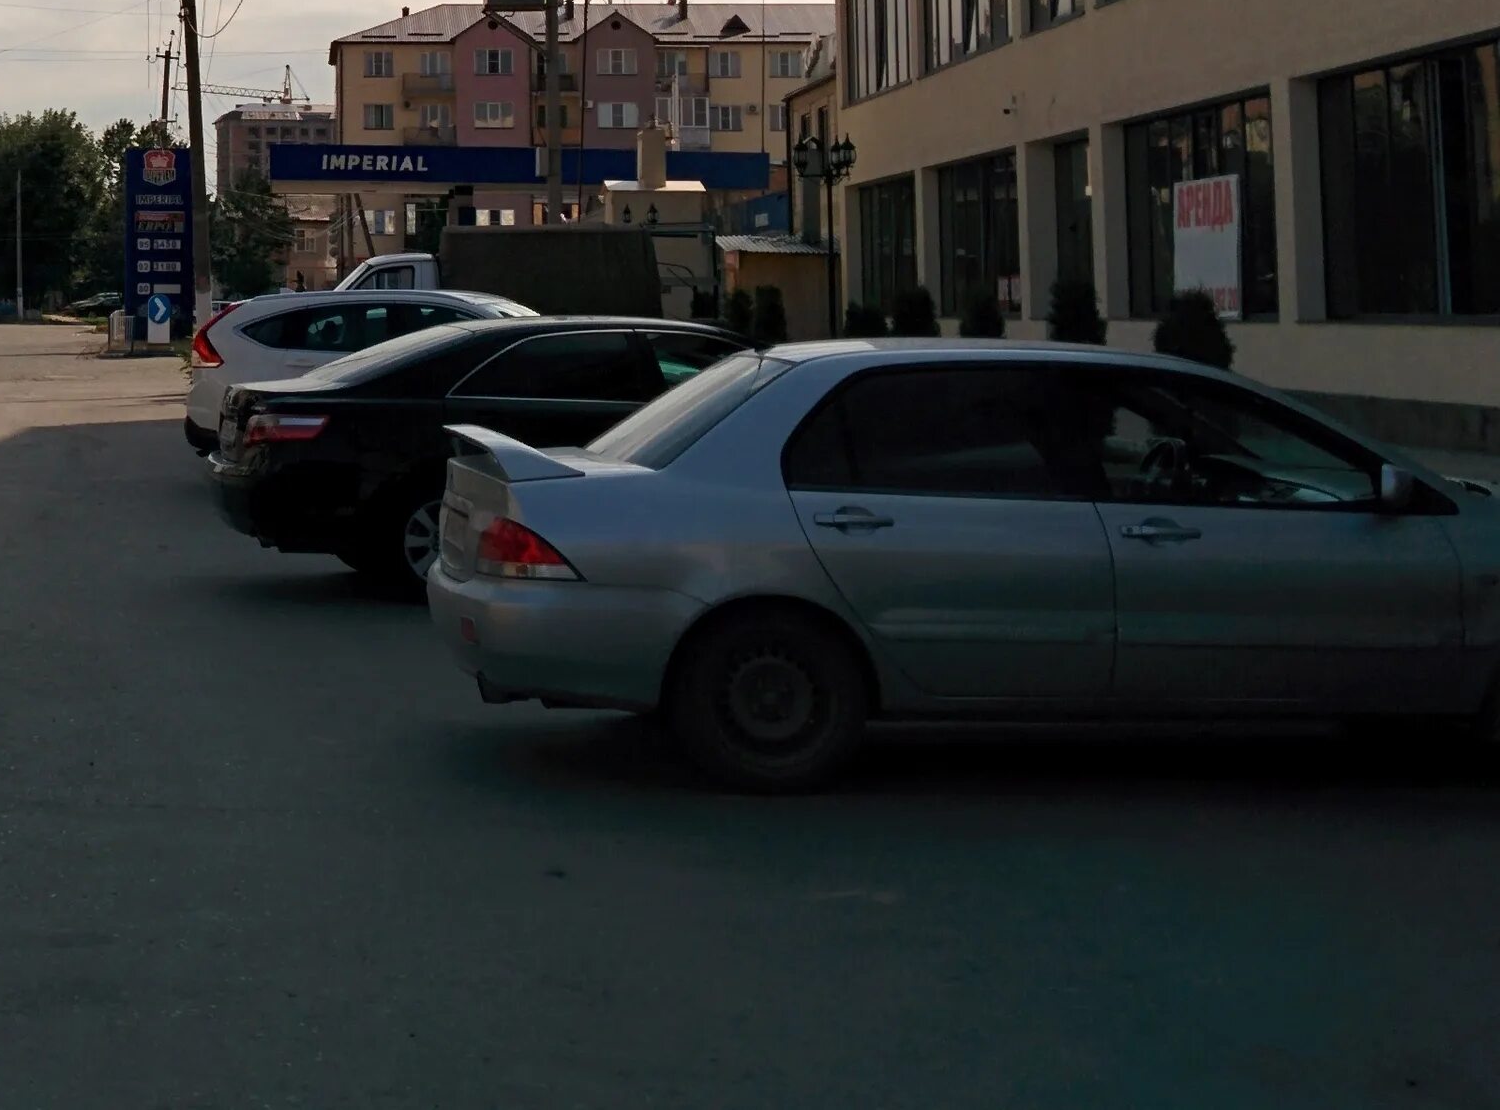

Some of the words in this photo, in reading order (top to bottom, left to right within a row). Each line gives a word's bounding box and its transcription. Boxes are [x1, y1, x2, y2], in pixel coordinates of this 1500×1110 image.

[322, 154, 428, 171] IMPERIAL
[135, 194, 184, 205] IMPERIAL
[1177, 180, 1233, 232] АРЕНДА
[138, 262, 149, 271] 92
